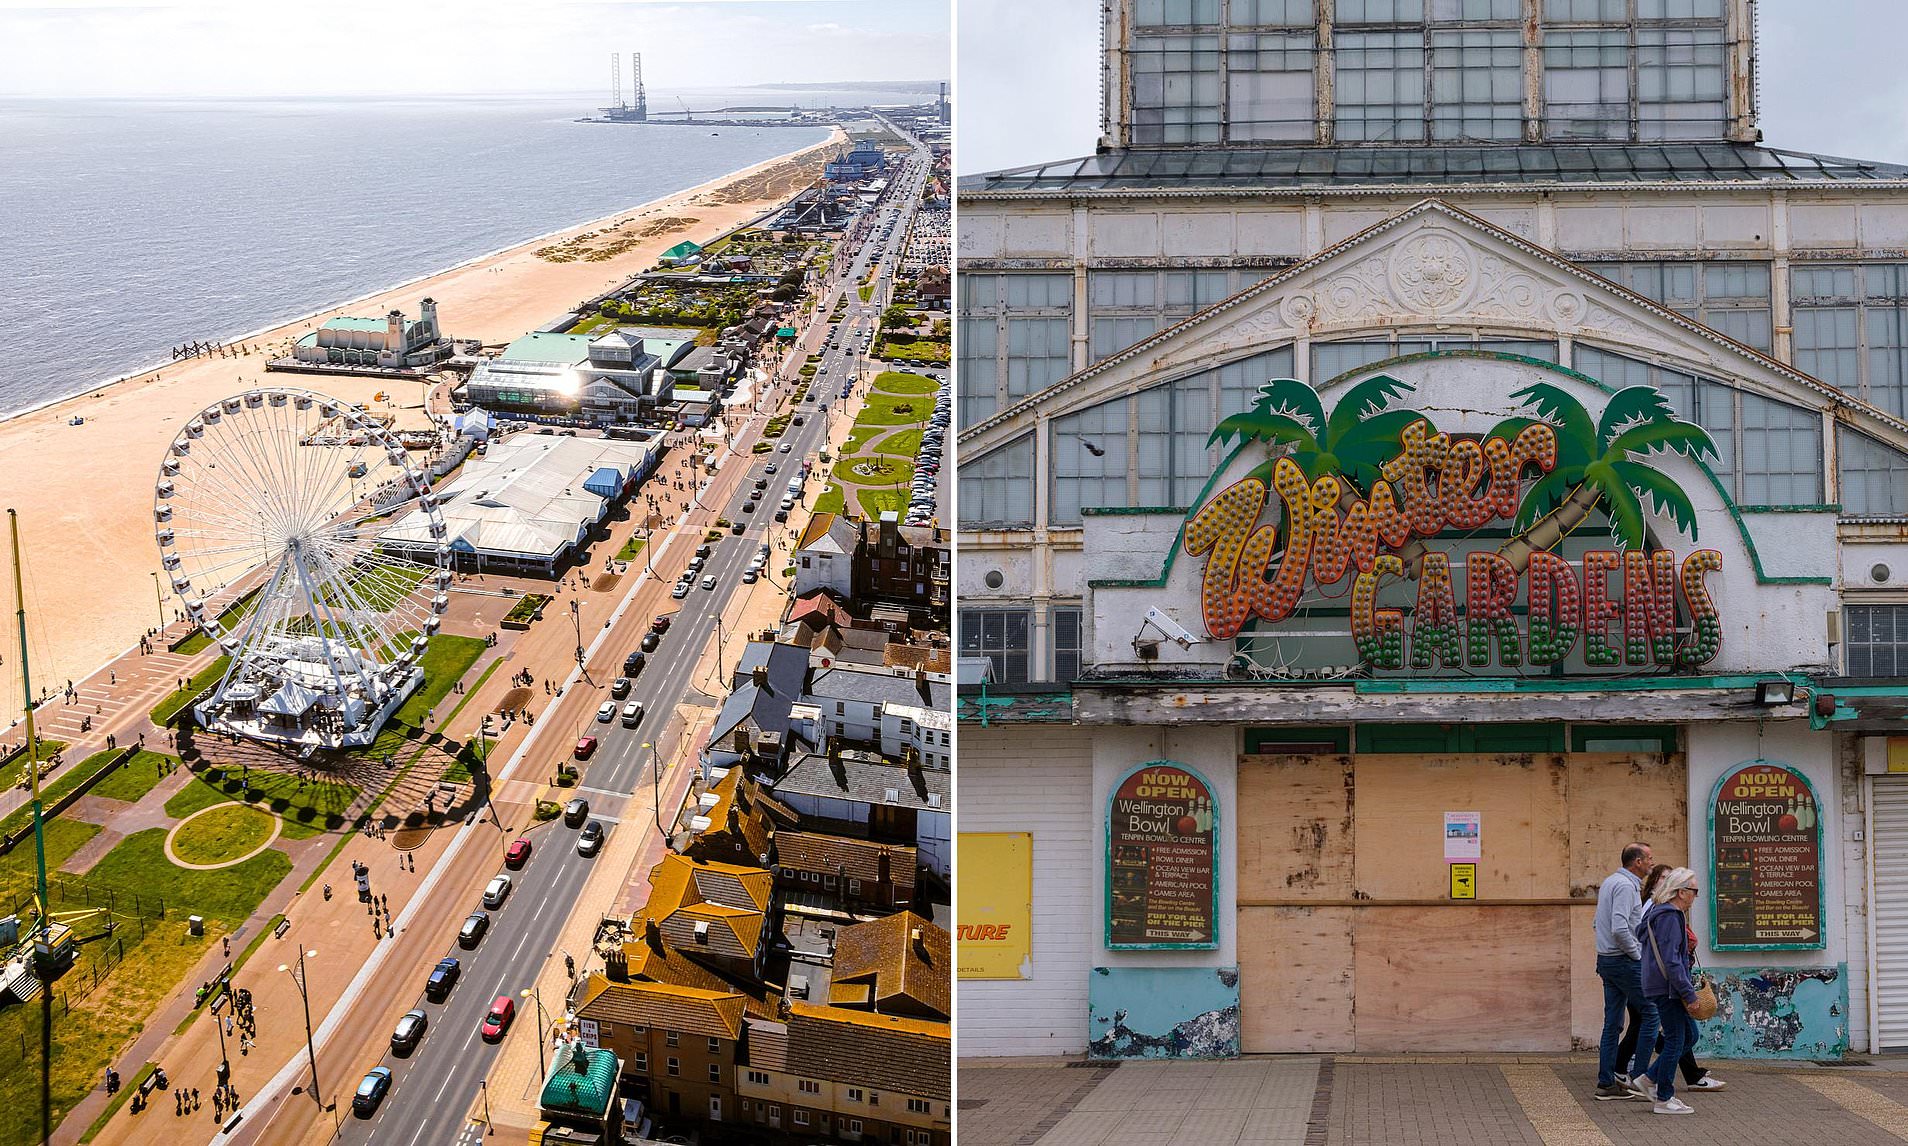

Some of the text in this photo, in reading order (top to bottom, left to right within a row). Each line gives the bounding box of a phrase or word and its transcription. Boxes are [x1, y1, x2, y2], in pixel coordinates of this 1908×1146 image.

[1184, 418, 1557, 640] Winter
[1350, 549, 1722, 669] GARDENS
[1142, 774, 1190, 786] NOW
[1740, 773, 1787, 785] NOW
[1136, 786, 1196, 798] OPEN
[1734, 786, 1794, 797] OPEN
[1119, 800, 1184, 818] Wellington
[1718, 801, 1783, 818] Wellington
[1130, 815, 1170, 832] Bowl
[1730, 816, 1770, 833] Bowl
[1180, 836, 1206, 844] CENTRE
[1190, 882, 1208, 890] POOL
